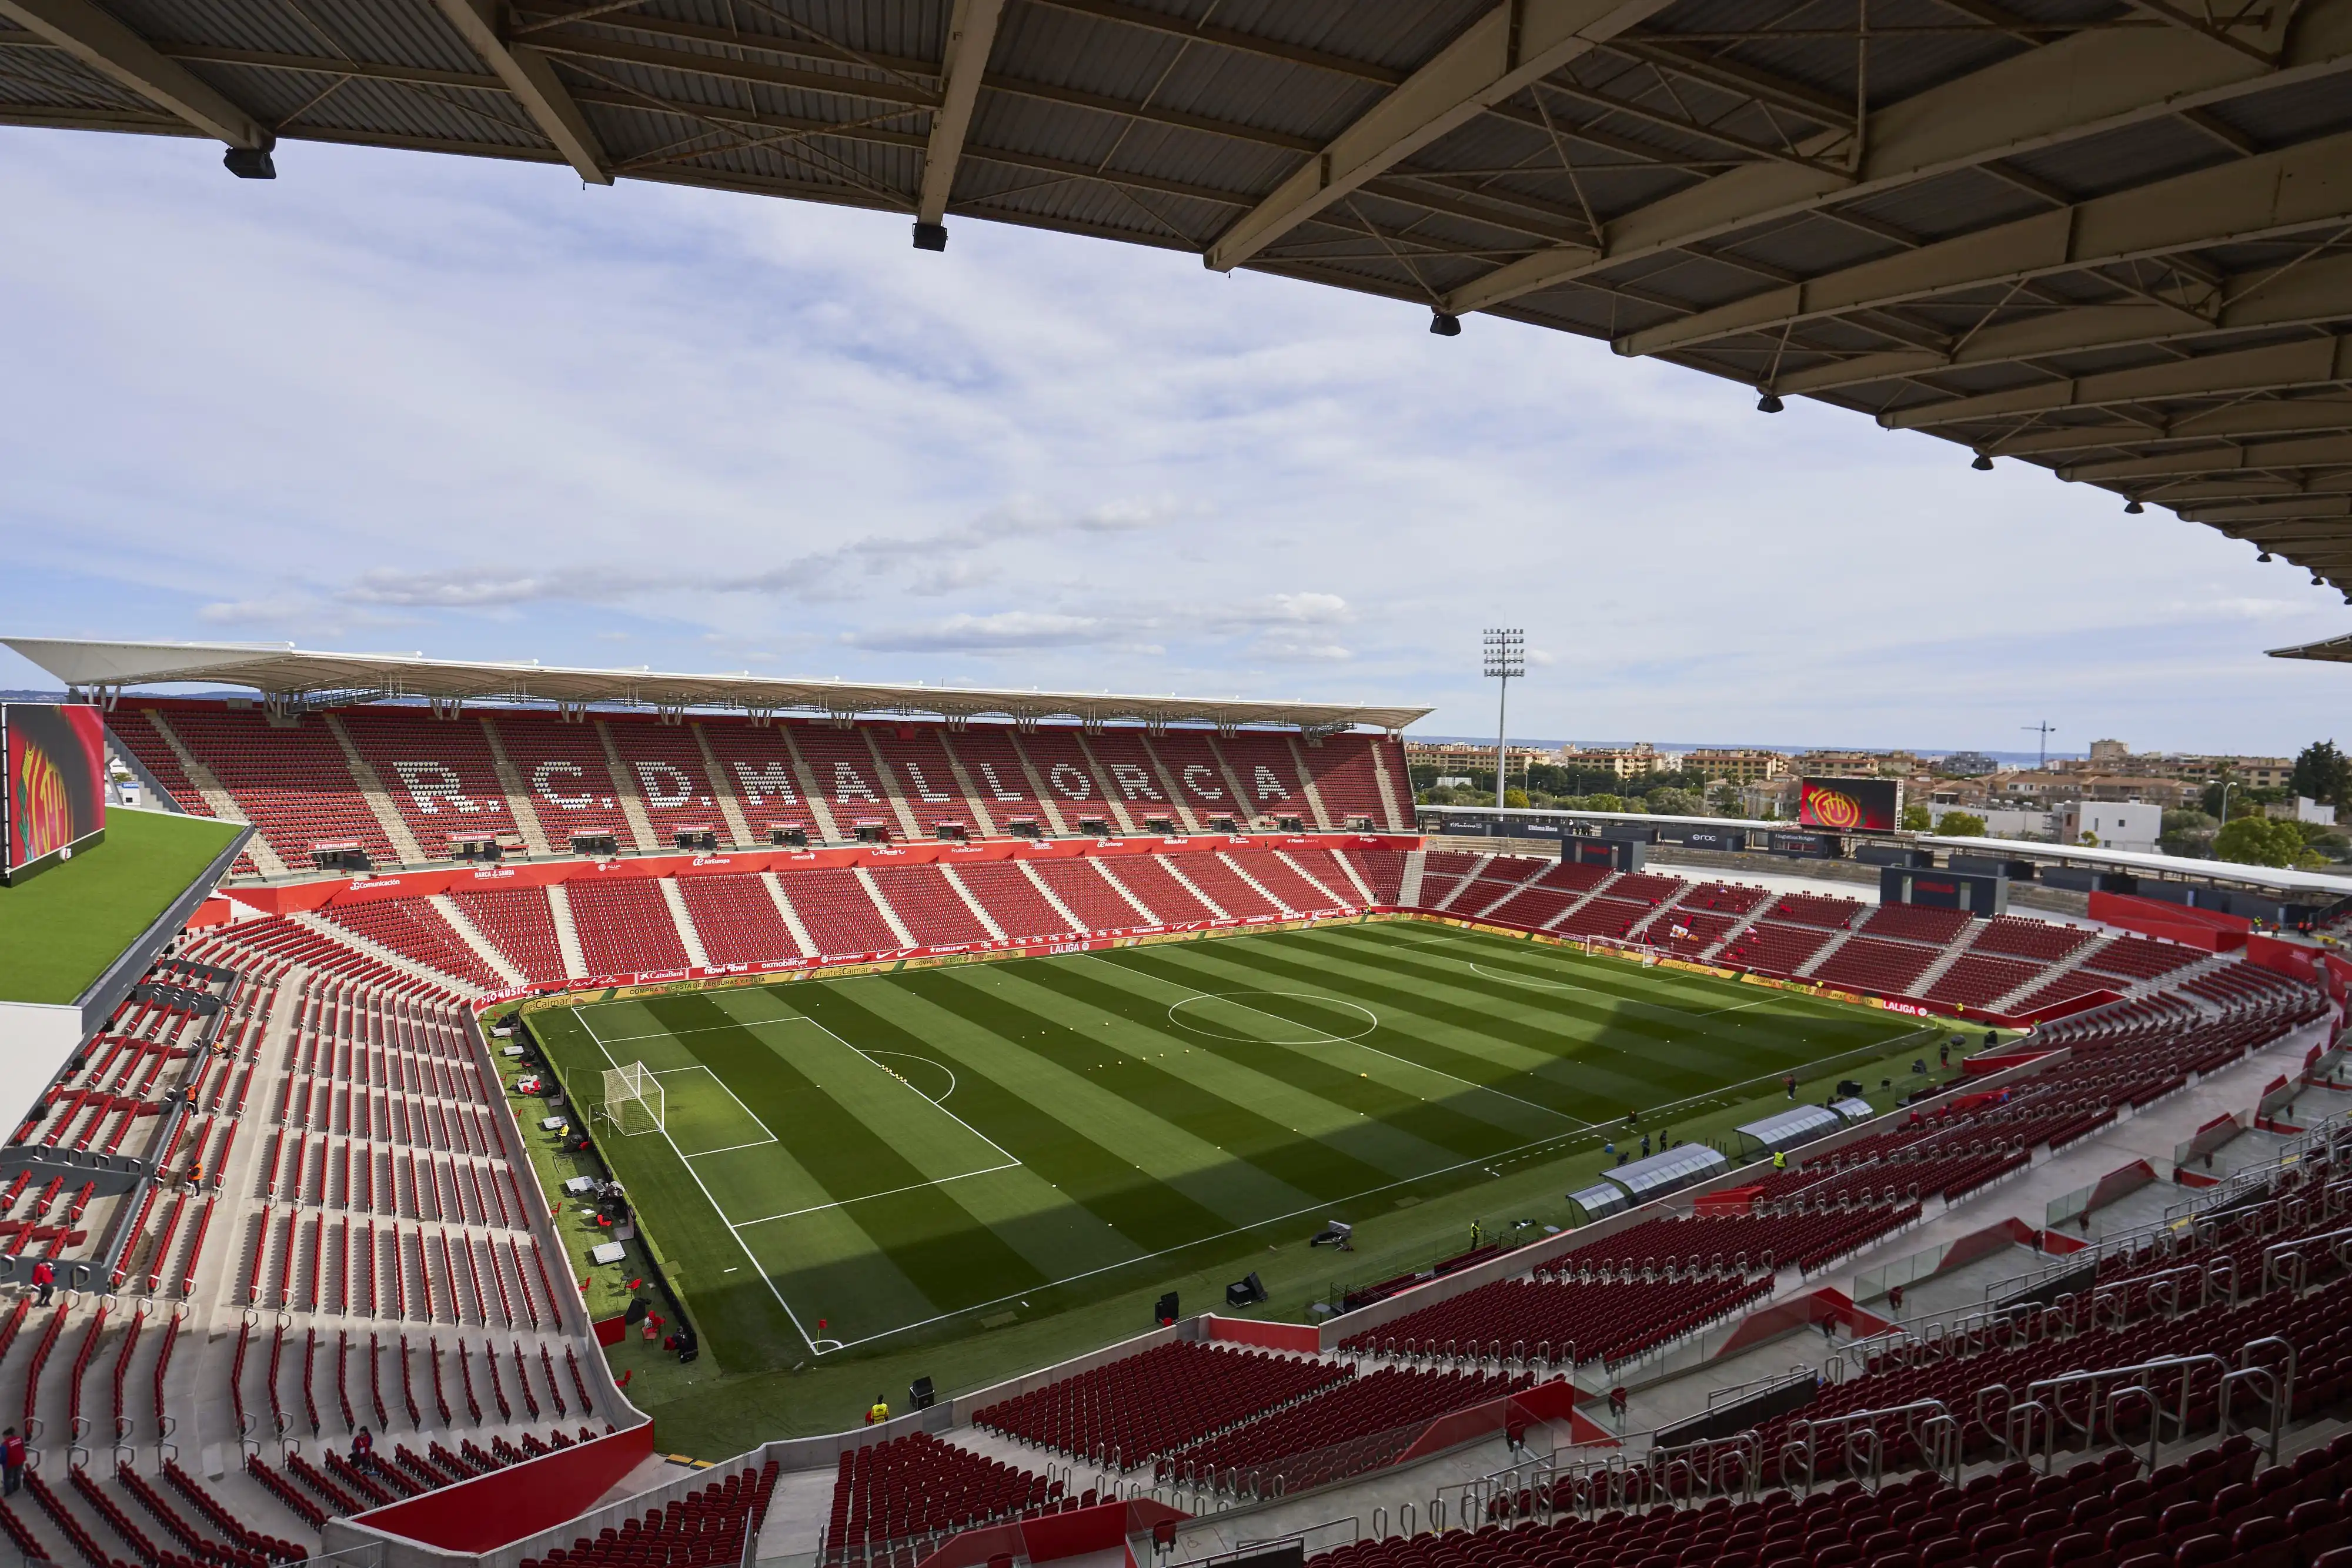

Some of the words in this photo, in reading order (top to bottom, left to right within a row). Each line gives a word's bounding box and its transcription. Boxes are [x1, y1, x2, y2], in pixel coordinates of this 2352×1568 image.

[734, 762, 1291, 805] MALLORCA
[359, 879, 400, 888] Comunicación
[1142, 935, 1182, 944] FruitesCaimari
[1050, 943, 1080, 955] LALIGA
[704, 964, 726, 975] fibwi
[815, 965, 871, 977] FruitesCaimari
[1662, 960, 1710, 974] FruitesCaimari
[650, 970, 684, 979] CaixaBank
[1753, 978, 1776, 986] COMPRA
[630, 987, 659, 995] COMPRA
[1883, 1001, 1916, 1014] LALIGA
